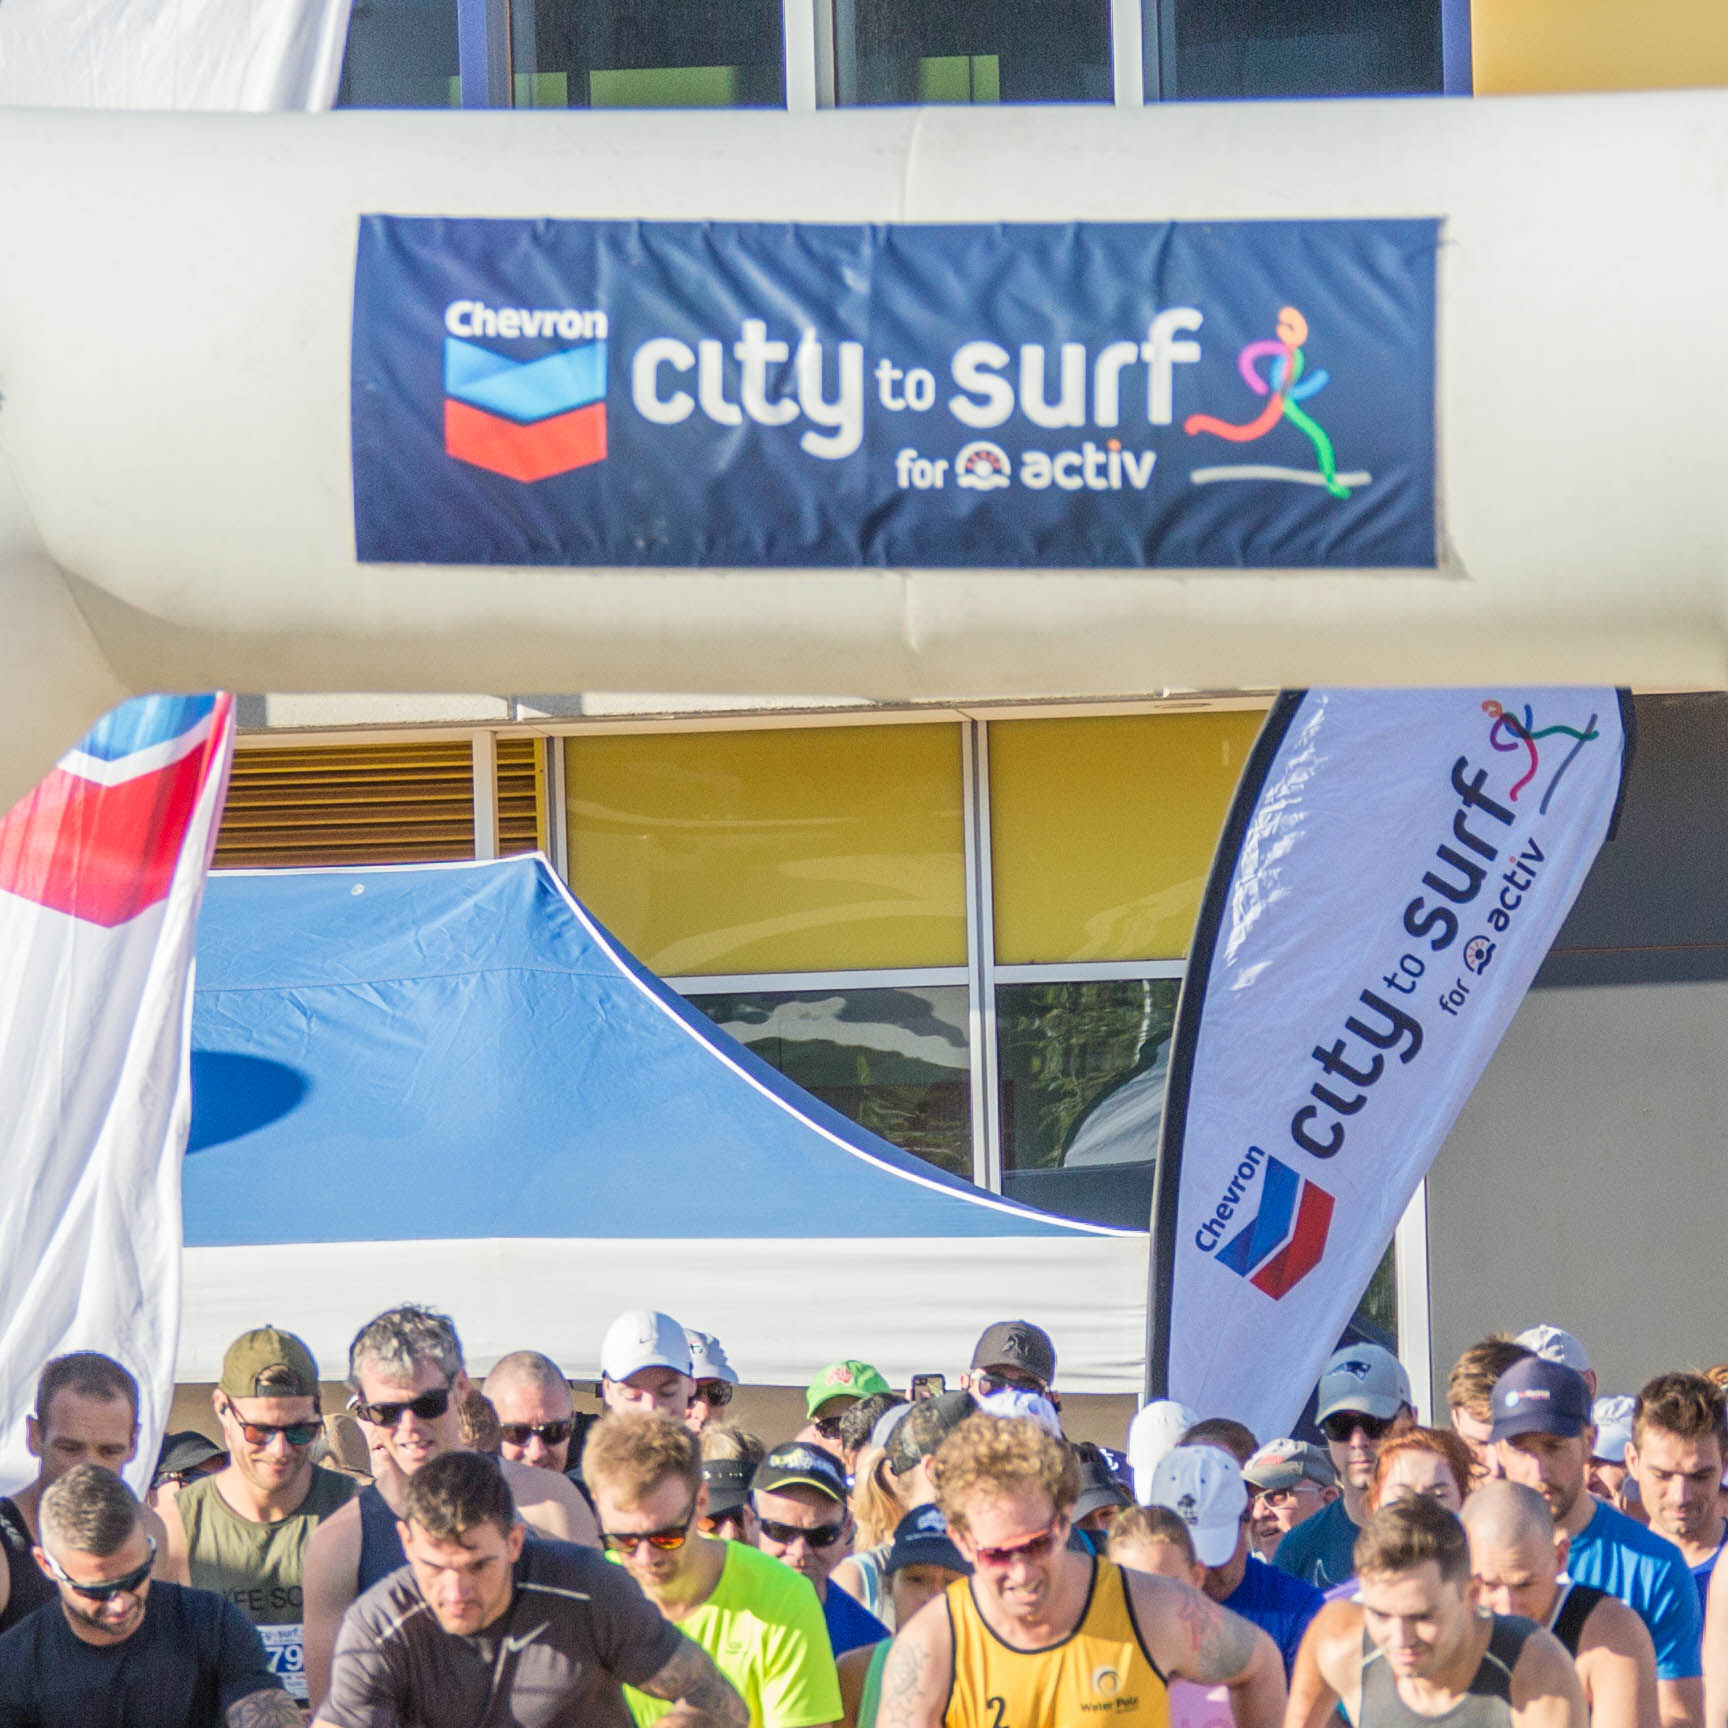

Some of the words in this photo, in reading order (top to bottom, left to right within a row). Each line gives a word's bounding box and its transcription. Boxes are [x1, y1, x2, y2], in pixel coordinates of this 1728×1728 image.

[445, 299, 607, 340] Chevron
[631, 317, 864, 460] city
[875, 359, 936, 411] to
[950, 306, 1202, 427] surf
[896, 446, 948, 489] for
[1022, 438, 1156, 490] activ
[1404, 756, 1516, 951] surf
[1383, 954, 1426, 996] to
[1440, 980, 1470, 1017] for
[1487, 838, 1545, 933] activ
[1291, 988, 1424, 1160] city
[1195, 1144, 1266, 1253] Chevron
[1081, 1702, 1113, 1712] Water
[1115, 1696, 1139, 1708] Polo
